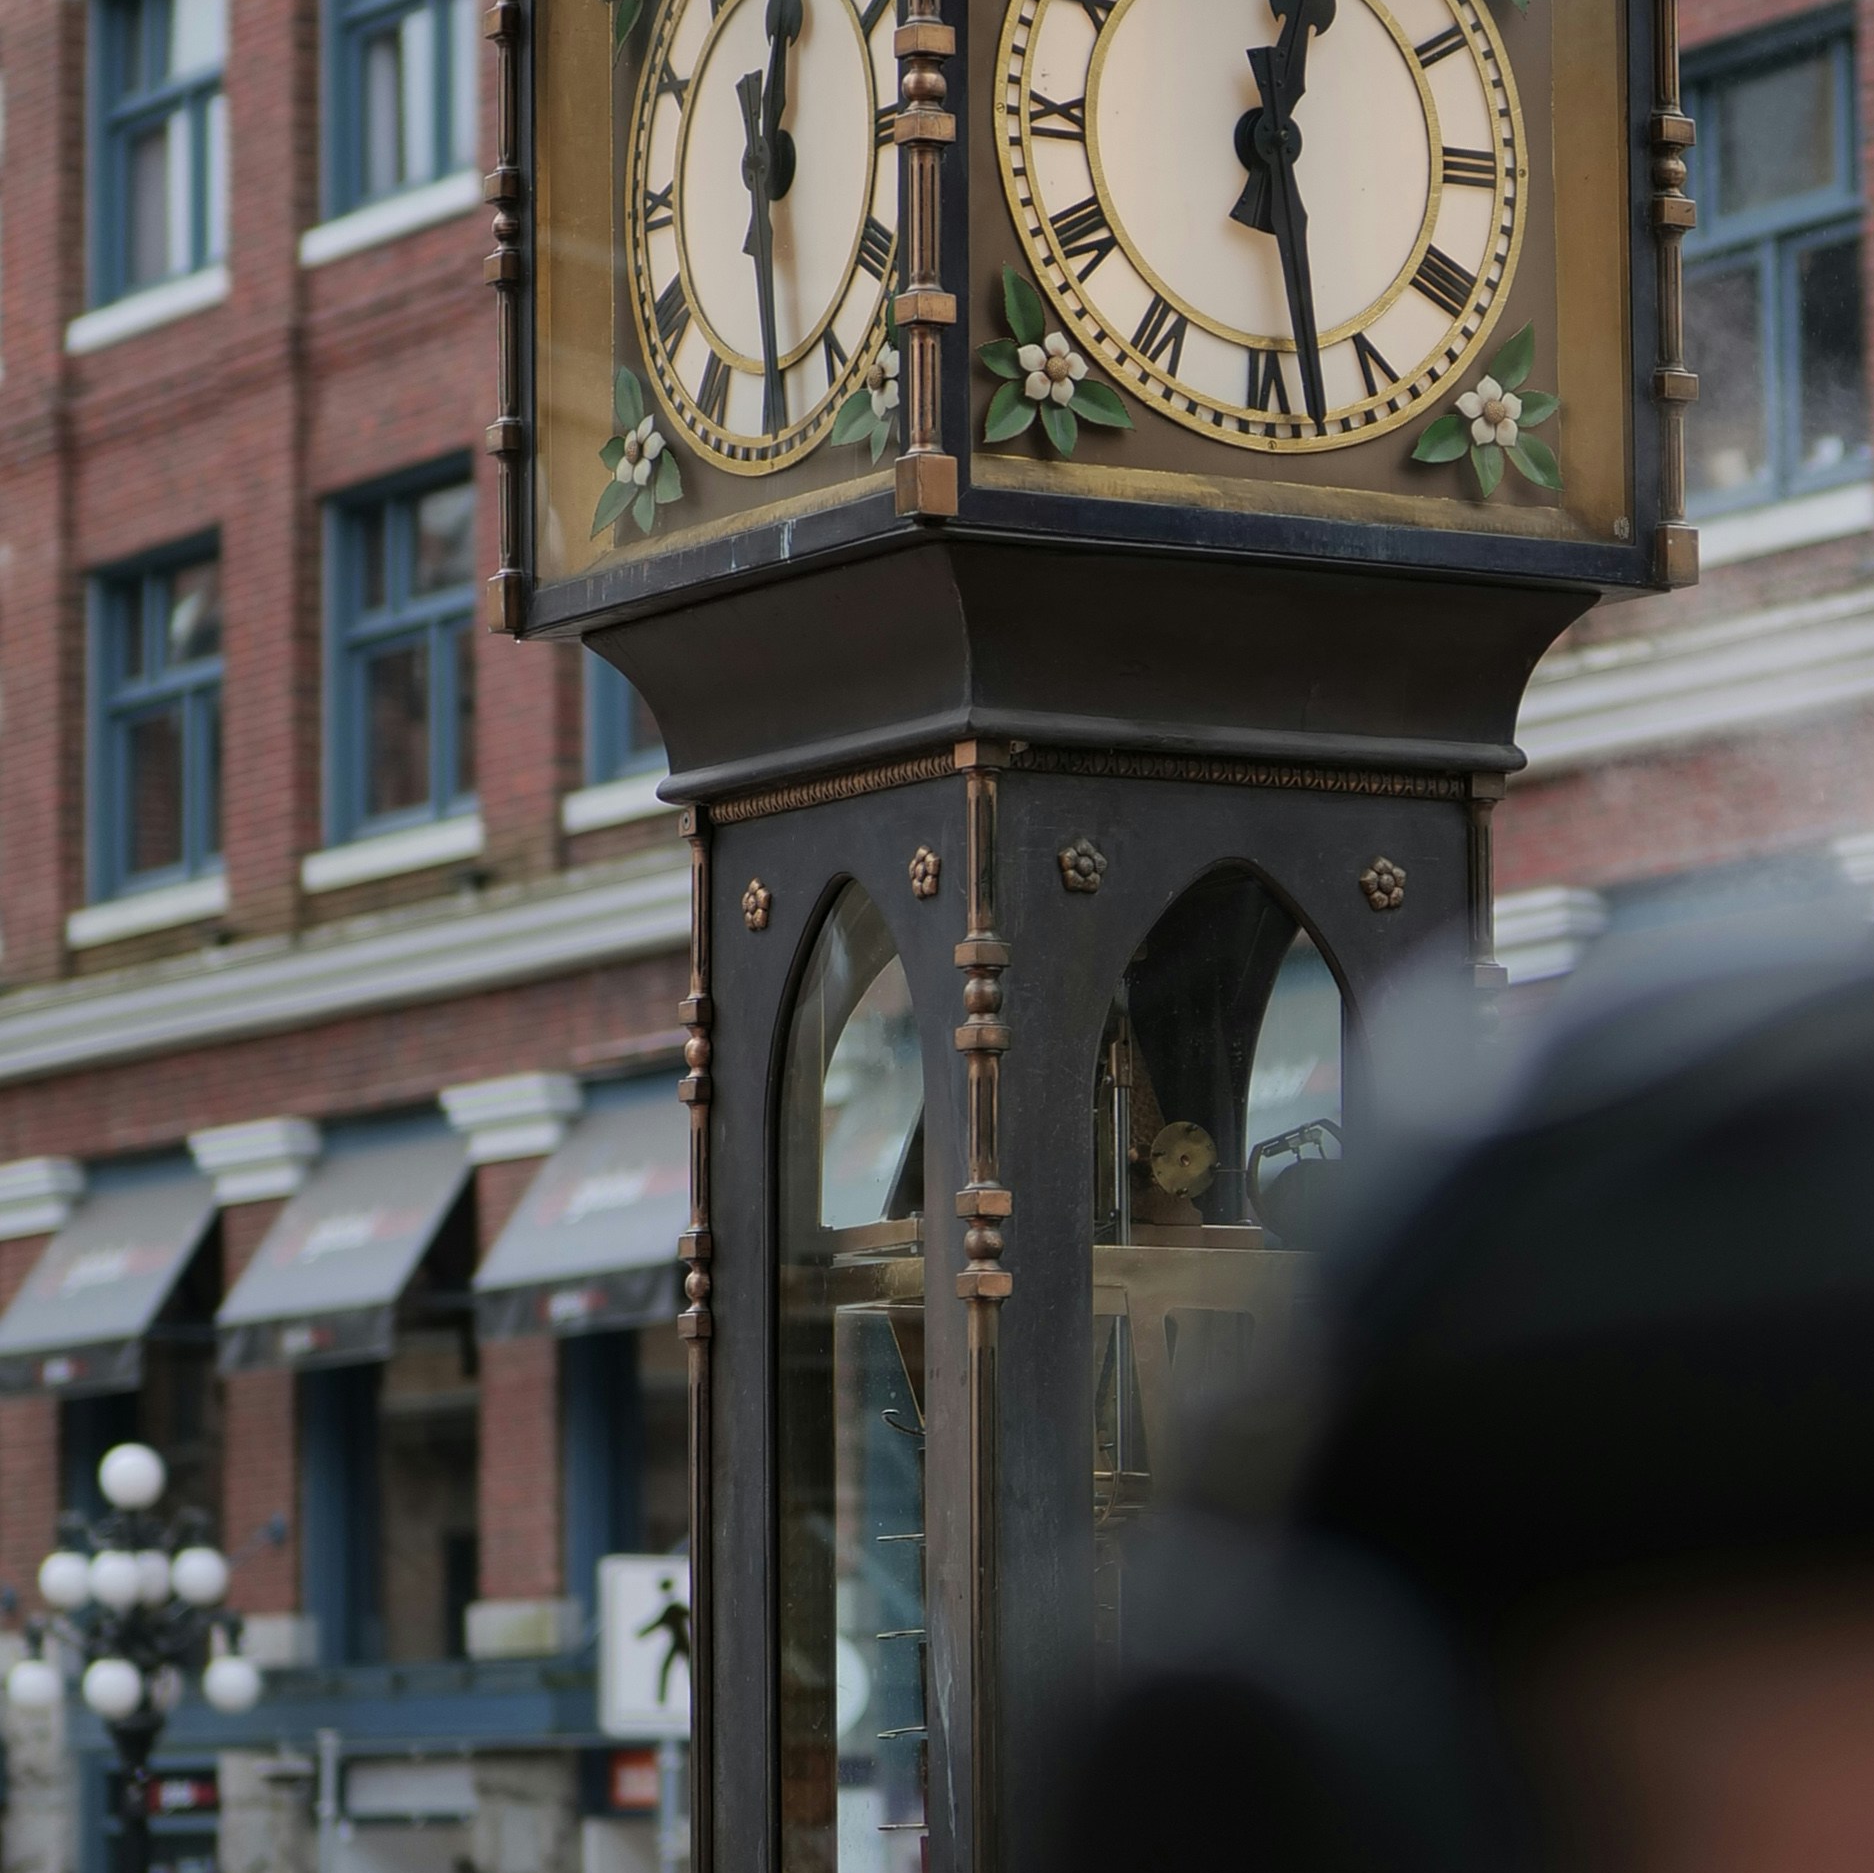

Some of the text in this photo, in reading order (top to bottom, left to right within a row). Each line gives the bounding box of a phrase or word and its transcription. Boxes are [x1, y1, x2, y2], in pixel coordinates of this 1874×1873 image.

[1414, 23, 1470, 70] II
[1030, 89, 1086, 143] IX
[1442, 146, 1496, 189] III
[1049, 194, 1119, 284] VIII
[1129, 293, 1189, 379] VII
[1352, 332, 1402, 397] V
[1247, 348, 1291, 415] VI
